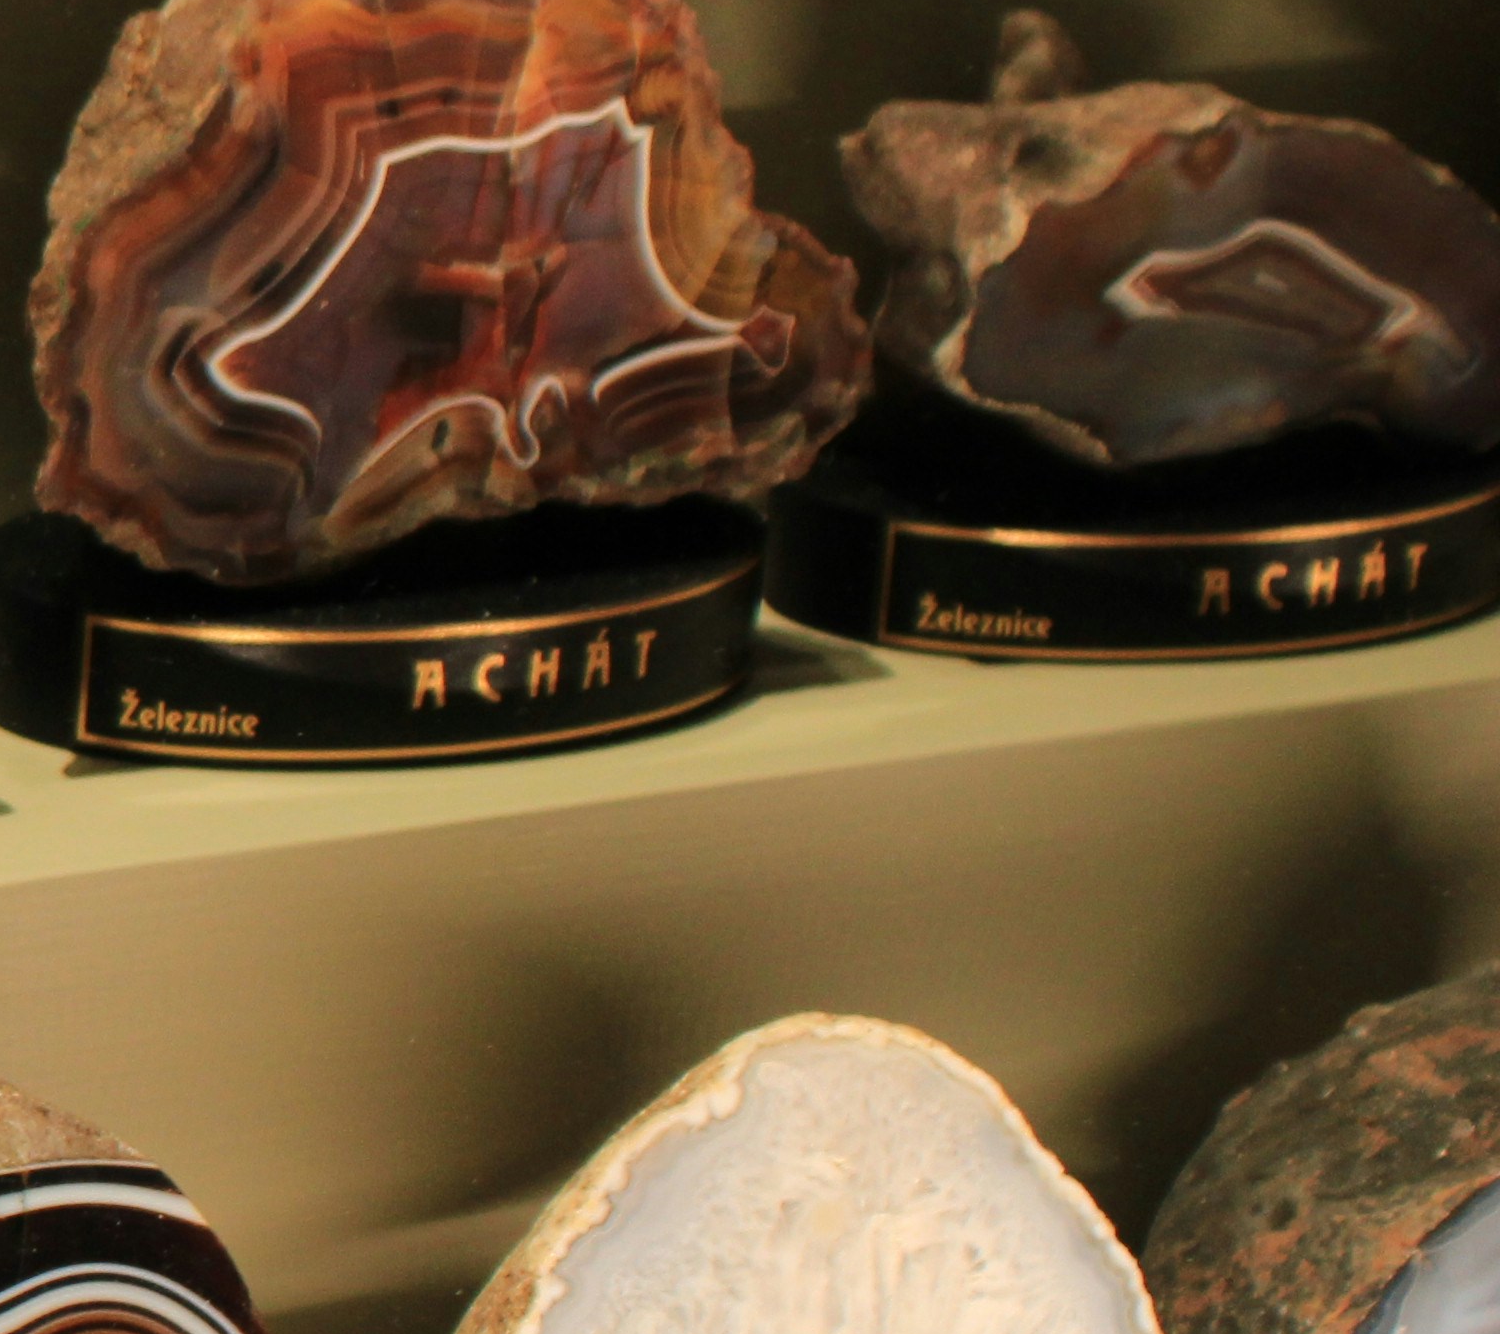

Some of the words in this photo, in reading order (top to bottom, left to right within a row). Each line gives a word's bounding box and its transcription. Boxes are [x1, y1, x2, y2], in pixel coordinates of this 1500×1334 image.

[1201, 541, 1428, 615] ACHÁT
[918, 594, 1051, 639] Železnice
[412, 629, 656, 707] ACHÁT
[121, 687, 259, 736] Železnice
